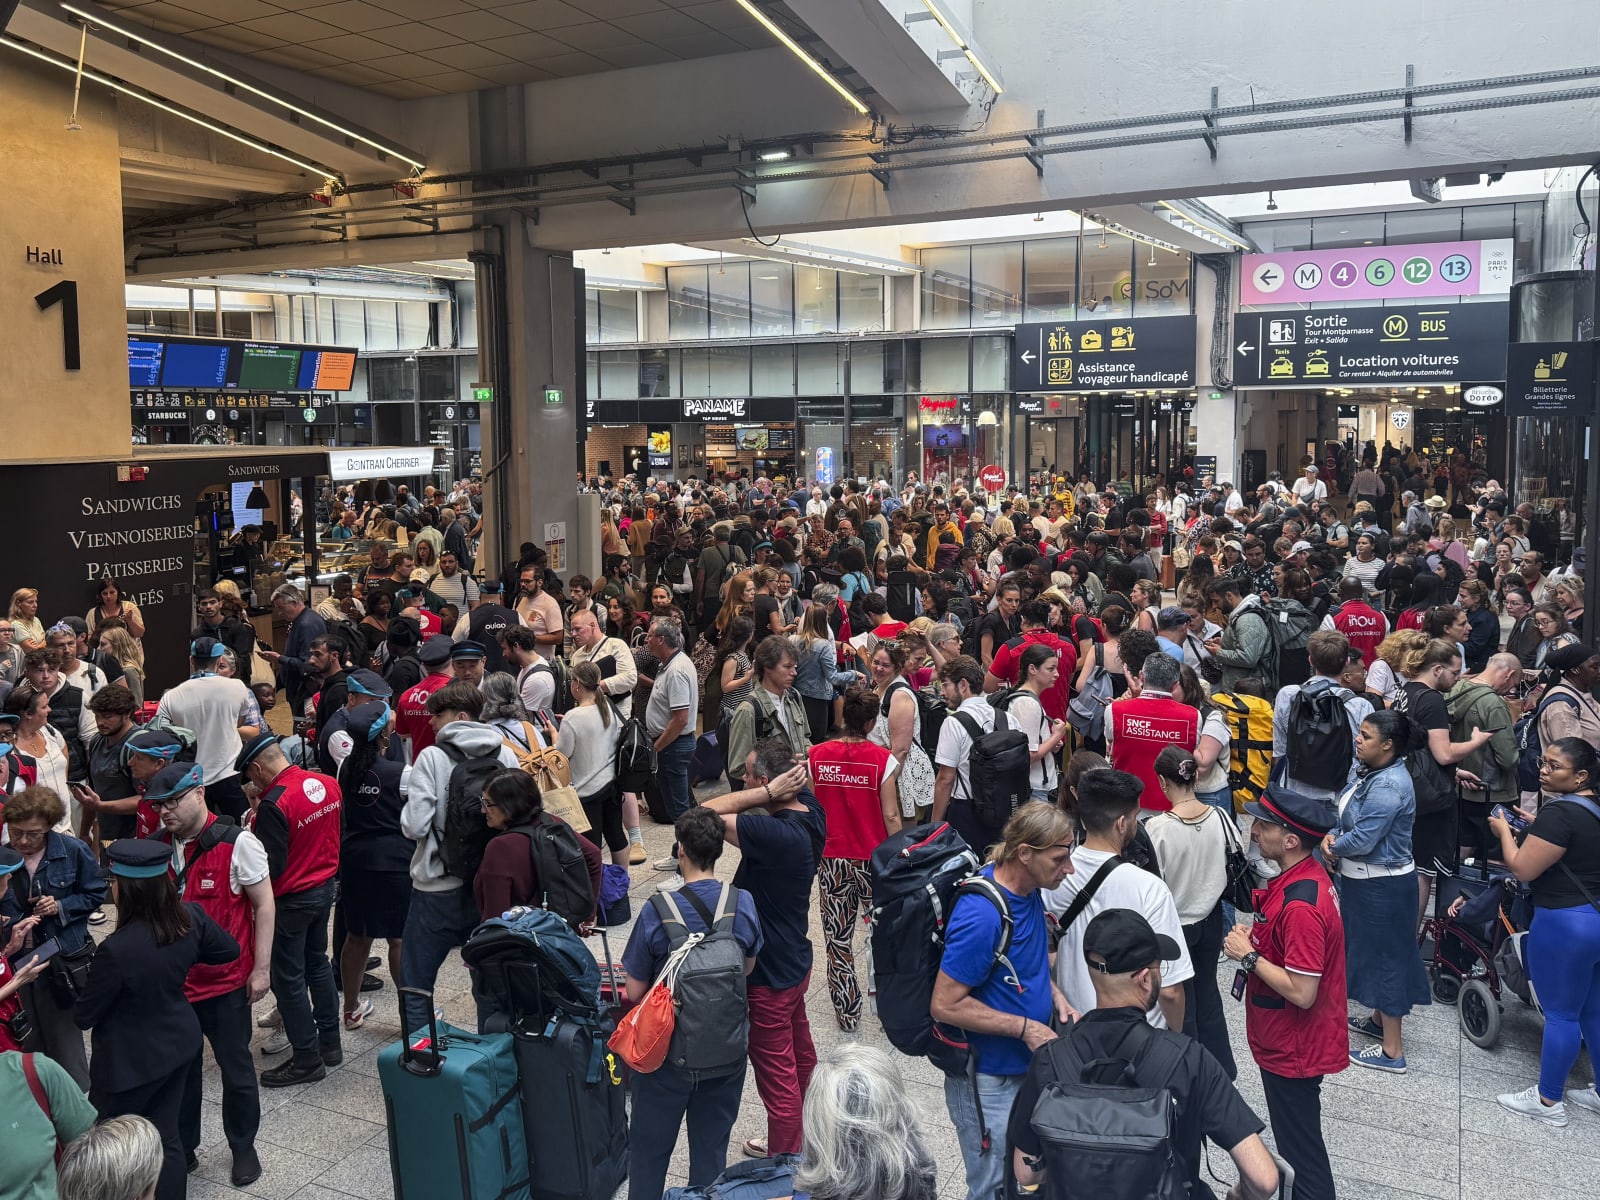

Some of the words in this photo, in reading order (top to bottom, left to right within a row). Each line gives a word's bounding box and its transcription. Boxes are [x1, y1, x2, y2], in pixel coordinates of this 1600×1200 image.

[26, 245, 64, 265] Hall
[1300, 270, 1315, 284] M
[1336, 267, 1349, 281] 4
[1374, 265, 1385, 280] 6
[1407, 262, 1428, 278] 12
[1445, 260, 1466, 276] 13
[34, 280, 81, 370] 1
[1304, 314, 1348, 328] Sortie
[1388, 320, 1403, 333] M
[1420, 319, 1446, 333] BUS
[1322, 327, 1374, 336] Montparnasse
[1325, 336, 1348, 344] Salida
[215, 347, 228, 383] départs
[1077, 362, 1136, 373] Assistance
[1339, 355, 1398, 367] Location
[1402, 354, 1460, 367] voitures
[1078, 374, 1127, 386] voyageur
[1130, 370, 1189, 384] handicapé
[1376, 370, 1402, 378] Alquiler
[1412, 368, 1454, 376] automóviles
[1554, 393, 1576, 401] lignes
[684, 399, 745, 417] PANAME
[147, 412, 187, 420] STARBUCKS
[228, 464, 280, 476] SANDWICHS
[81, 494, 182, 516] SANDWICHS
[67, 524, 194, 550] VIENNOISERIES
[86, 556, 184, 581] PÂTISSERIES
[122, 588, 164, 607] AFÉS
[1126, 718, 1152, 729] SNCF
[1126, 726, 1181, 740] ASSISTANCE
[818, 764, 841, 775] SNCF
[818, 773, 869, 785] ASSISTANCE
[304, 808, 324, 825] VOTRE
